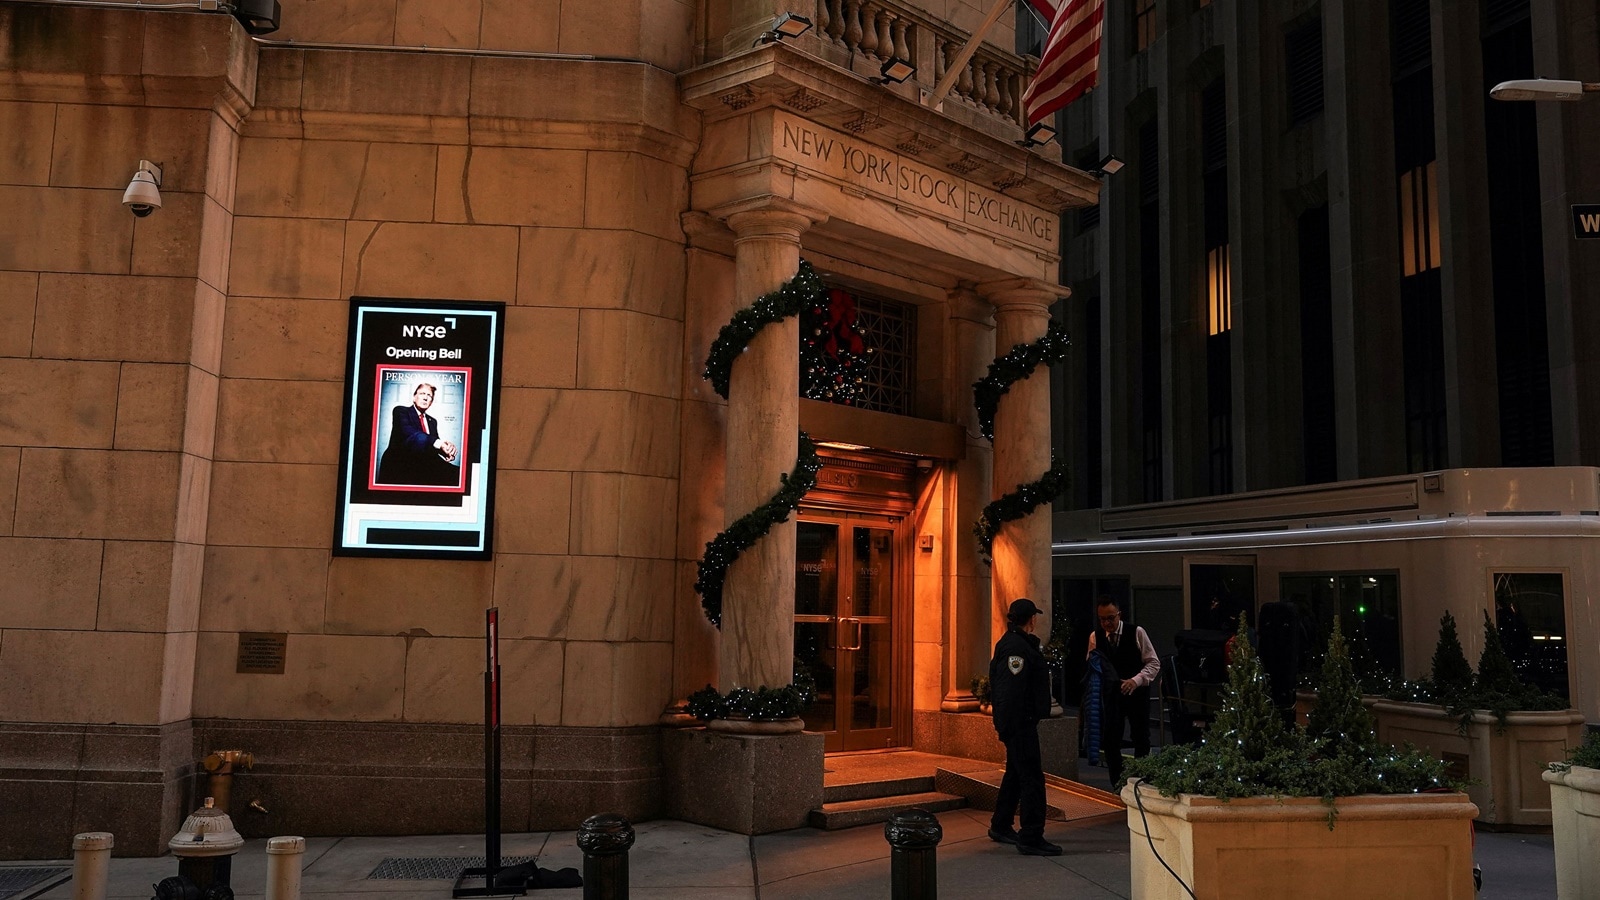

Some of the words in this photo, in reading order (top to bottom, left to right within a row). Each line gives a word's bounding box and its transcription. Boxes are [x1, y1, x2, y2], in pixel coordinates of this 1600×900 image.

[782, 121, 833, 162] NEW
[839, 142, 893, 186] YORK
[899, 165, 960, 209] STOCK
[967, 191, 1052, 241] EXCHANGE
[386, 346, 437, 360] Opening
[439, 348, 462, 359] Bell
[434, 374, 462, 383] YEAR
